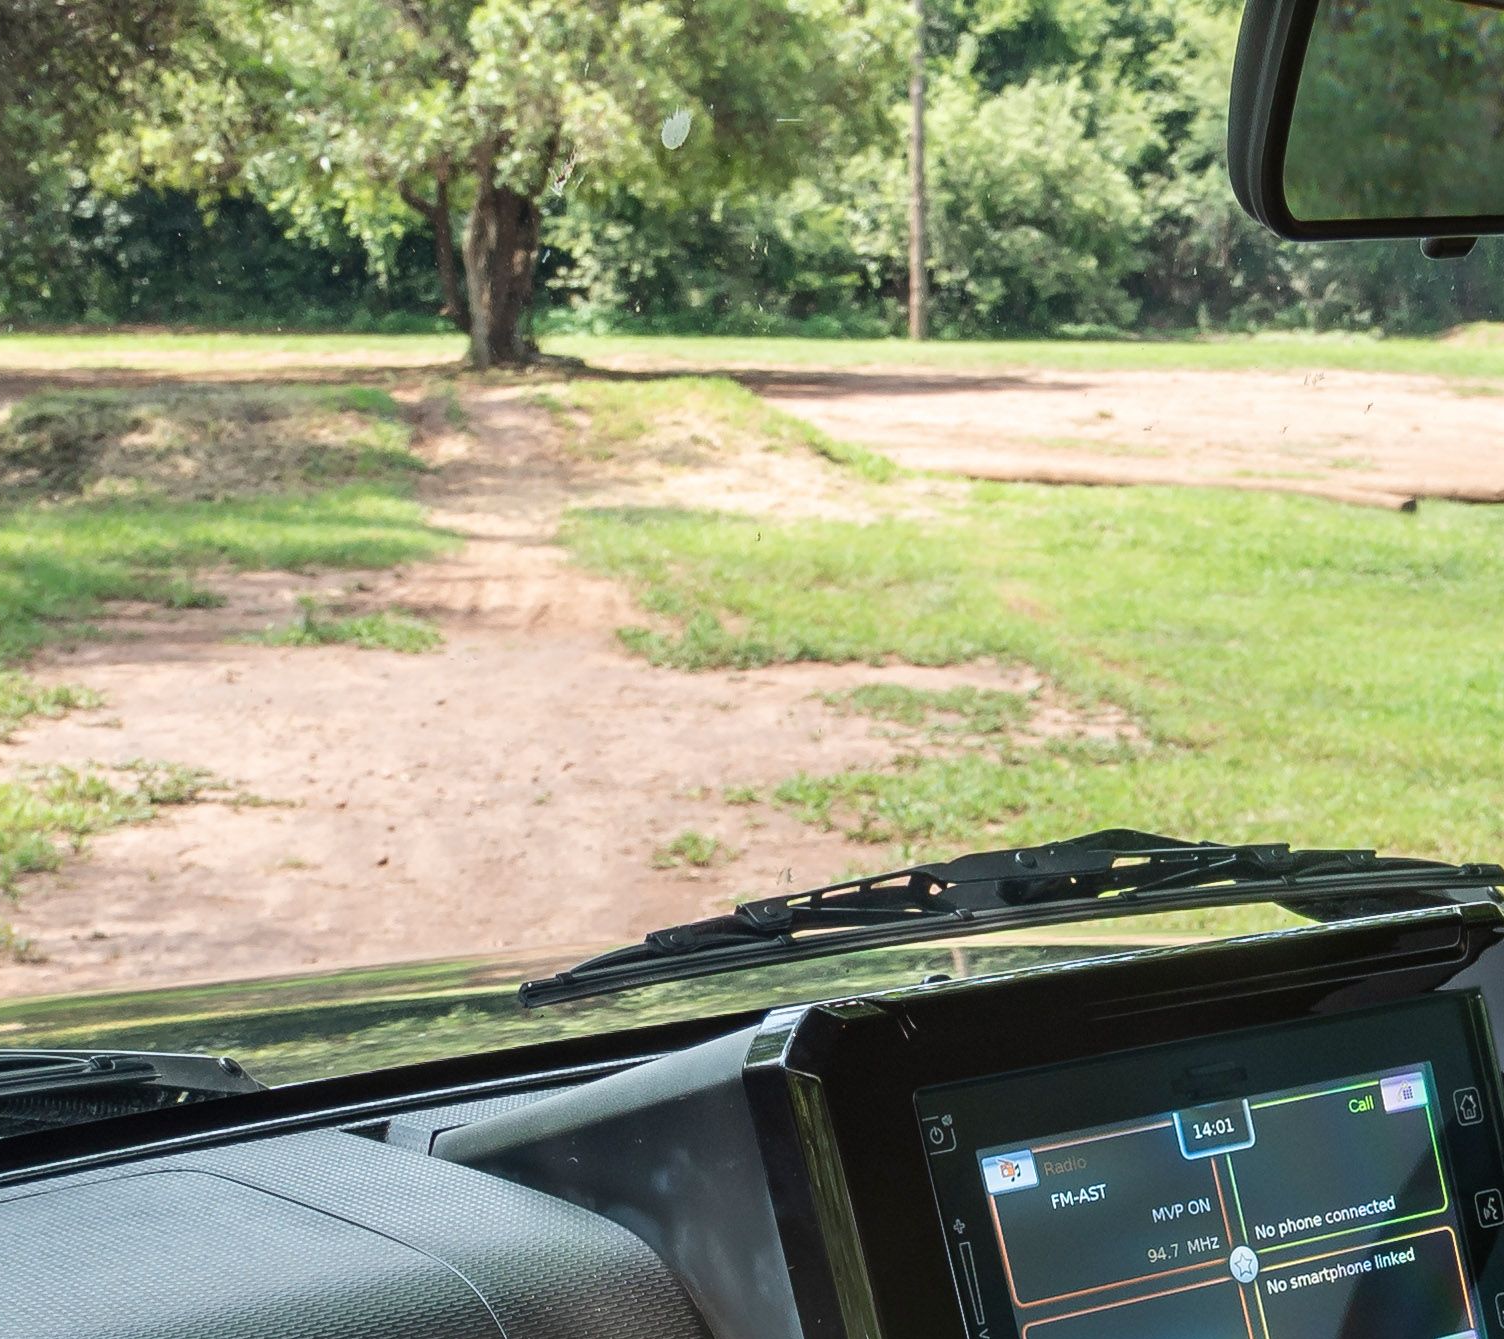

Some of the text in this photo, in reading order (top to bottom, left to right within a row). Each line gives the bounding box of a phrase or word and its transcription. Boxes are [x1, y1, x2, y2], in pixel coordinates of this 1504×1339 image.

[1348, 1095, 1374, 1113] Call
[1192, 1118, 1234, 1139] 14:01
[1044, 1157, 1087, 1176] Radio
[1050, 1183, 1107, 1209] FM-AST
[1152, 1198, 1211, 1223] MVP ON
[1255, 1195, 1397, 1240] No phone connected
[1147, 1236, 1220, 1263] 94.7 MHz
[1266, 1247, 1416, 1295] No smartphone linked
